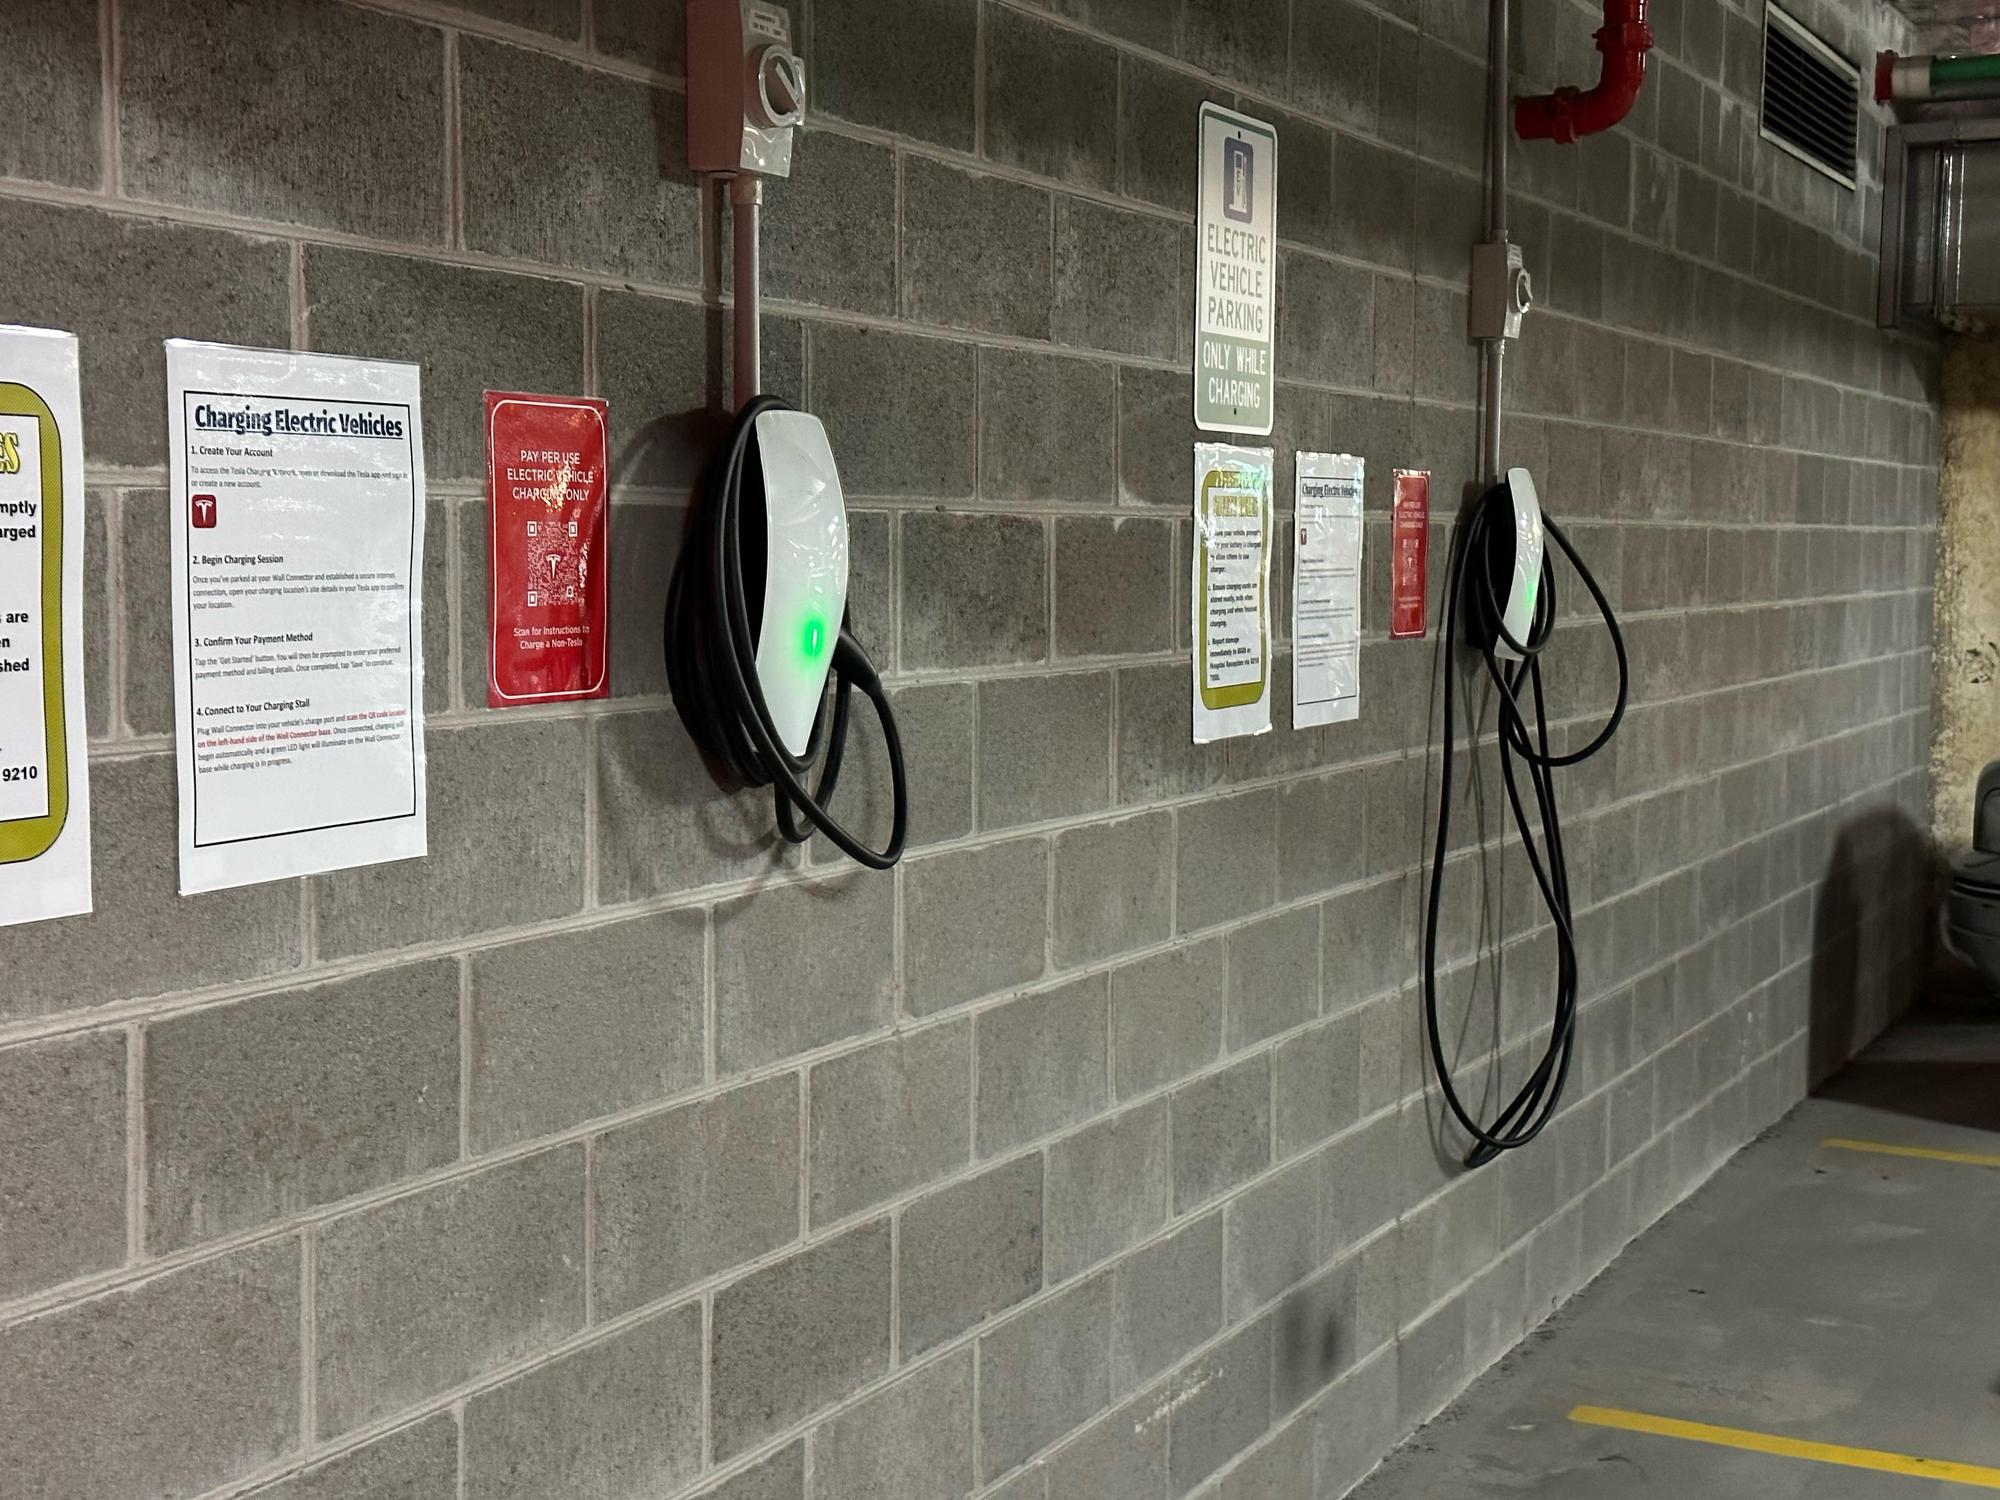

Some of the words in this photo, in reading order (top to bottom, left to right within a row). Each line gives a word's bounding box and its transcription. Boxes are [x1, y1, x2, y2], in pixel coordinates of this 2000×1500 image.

[1207, 222, 1266, 264] ELECTRIC
[1210, 259, 1263, 298] VEHICLE
[1208, 296, 1263, 334] PARKING
[1203, 340, 1231, 370] ONLY
[1236, 346, 1266, 375] WHILE
[1208, 377, 1260, 409] CHARGING
[195, 404, 272, 436] Charging
[275, 409, 337, 433] Electric
[339, 411, 403, 437] Vehicles
[191, 445, 198, 455] 1.
[199, 446, 224, 455] Create
[225, 447, 242, 456] Your
[244, 448, 273, 457] Account
[520, 450, 539, 462] PAY
[541, 451, 560, 463] PER
[562, 452, 580, 464] USE
[219, 466, 229, 474] the
[230, 467, 246, 475] Tesla
[507, 468, 554, 481] ELECTRIC
[565, 488, 590, 500] ONLY
[193, 555, 200, 564] 2.
[202, 555, 223, 566] Begin
[224, 554, 256, 566] Charging
[257, 554, 284, 564] Session
[192, 575, 208, 583] Once
[230, 575, 250, 583] parked
[244, 588, 258, 596] your
[258, 587, 282, 595] charging
[193, 602, 207, 610] your
[6, 612, 29, 624] are
[513, 627, 530, 636] Scan
[531, 626, 542, 636] for
[543, 626, 581, 635] Instructions
[194, 638, 202, 647] 3.
[203, 637, 233, 647] Confirm
[234, 636, 252, 644] Your
[253, 634, 284, 645] Payment
[286, 632, 313, 642] Method
[520, 640, 545, 650] Charge
[551, 637, 583, 648] Non-Tesla
[196, 707, 204, 716] 4.
[204, 706, 235, 715] Connect
[236, 705, 244, 713] to
[245, 704, 262, 712] Your
[263, 700, 294, 711] Charging
[295, 698, 310, 708] Stall
[197, 727, 210, 735] Plug
[211, 726, 224, 734] Wall
[225, 724, 255, 732] Connector
[255, 722, 267, 730] into
[305, 717, 322, 725] charge
[323, 716, 335, 724] port
[336, 714, 345, 722] and
[206, 739, 216, 747] the
[217, 736, 245, 746] left-hand
[246, 736, 258, 744] side
[258, 734, 265, 742] of
[265, 733, 275, 741] the
[276, 732, 289, 740] Wall
[289, 729, 318, 738] Connector
[270, 745, 286, 754] green
[287, 743, 297, 751] LED
[355, 736, 363, 744] the
[2, 765, 38, 782] 9210
[198, 766, 213, 774] base
[213, 764, 229, 772] while
[230, 761, 255, 770] charging
